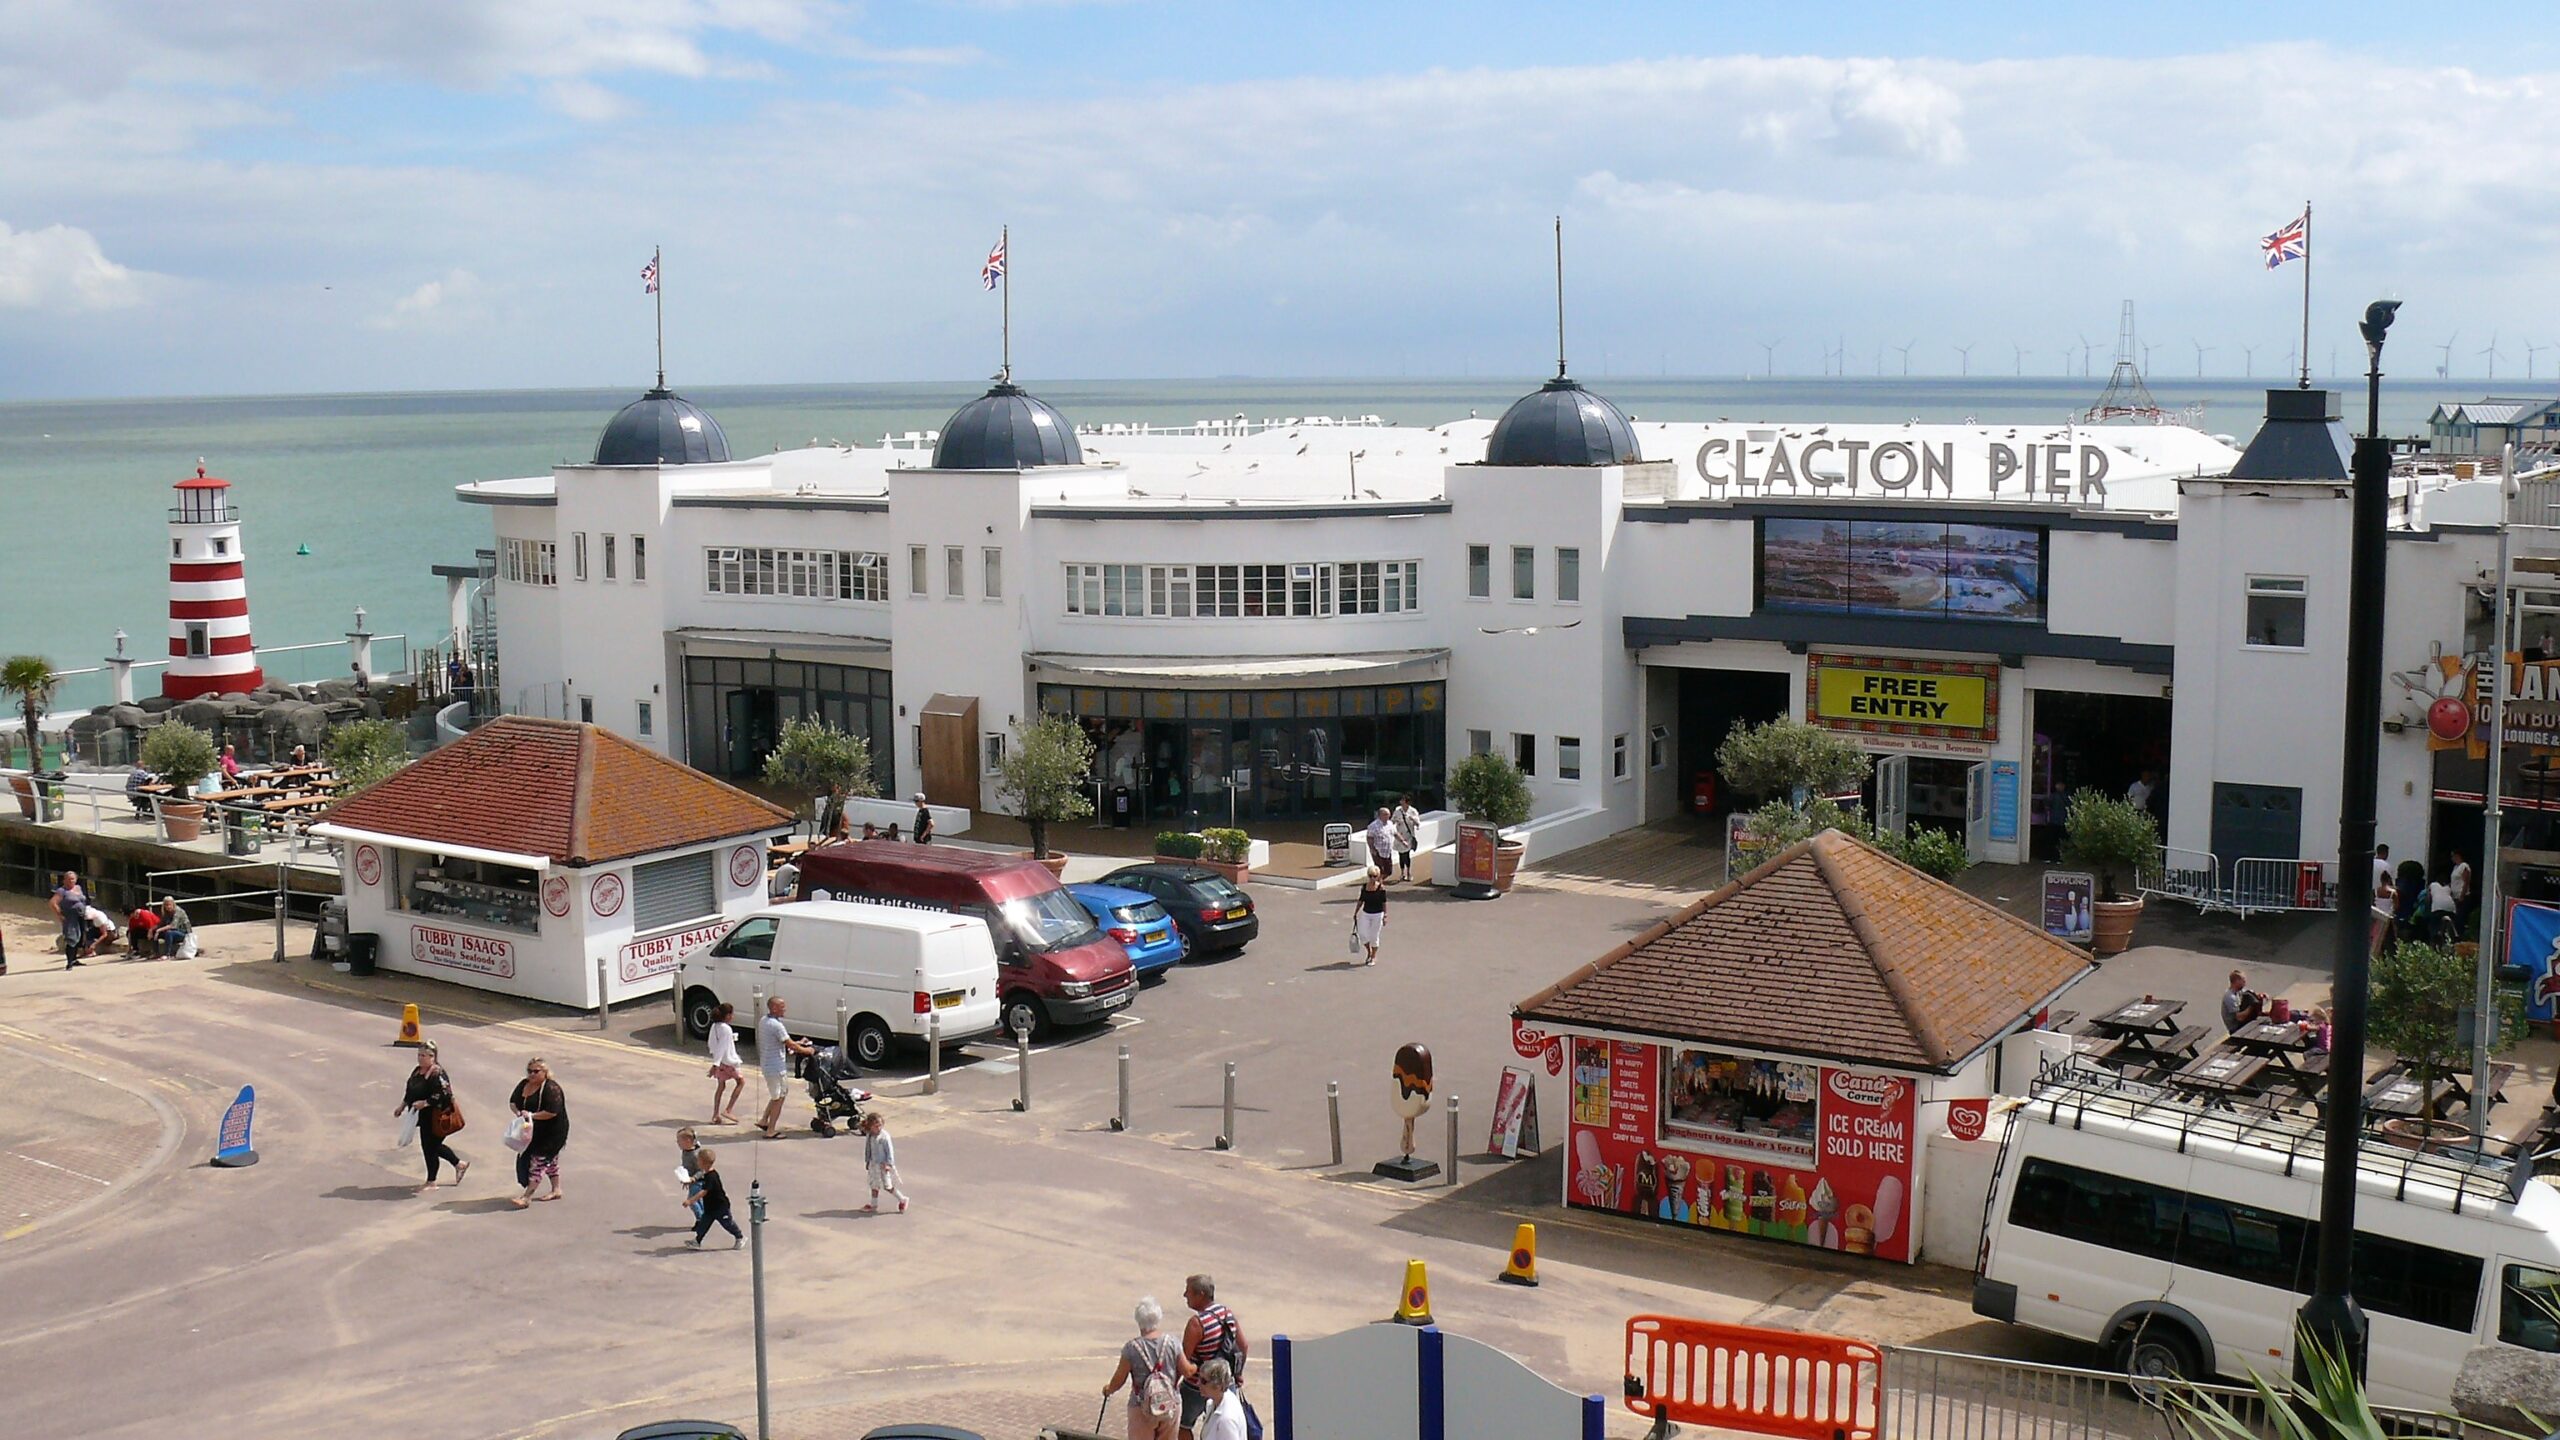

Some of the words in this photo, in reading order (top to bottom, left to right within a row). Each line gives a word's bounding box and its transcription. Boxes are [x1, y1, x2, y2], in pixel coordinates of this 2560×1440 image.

[1697, 438, 1953, 493] CLACTON
[1989, 443, 2109, 495] PIER
[1864, 676, 1937, 698] FREE
[1081, 690, 1222, 718] FISH
[1263, 686, 1437, 718] CHIPS
[1851, 696, 1949, 719] ENTRY
[2504, 728, 2550, 746] LOUNGE
[2047, 876, 2089, 886] BOWLING
[836, 892, 876, 905] Clacton
[880, 898, 902, 908] Self
[418, 929, 456, 947] TUBBY
[461, 936, 506, 957] ISAACS
[629, 938, 673, 960] TUBBY
[429, 945, 457, 959] Quality
[460, 951, 495, 965] Seafoods
[642, 955, 674, 968] Quality
[1829, 1113, 1849, 1133] ICE
[1854, 1117, 1903, 1141] CREAM
[1951, 1123, 1979, 1137] WALL'S
[1663, 1125, 1713, 1140] Doughnuts
[1733, 1137, 1754, 1148] each
[1777, 1144, 1792, 1153] for
[1827, 1136, 1864, 1158] SOLD
[1869, 1141, 1904, 1164] HERE
